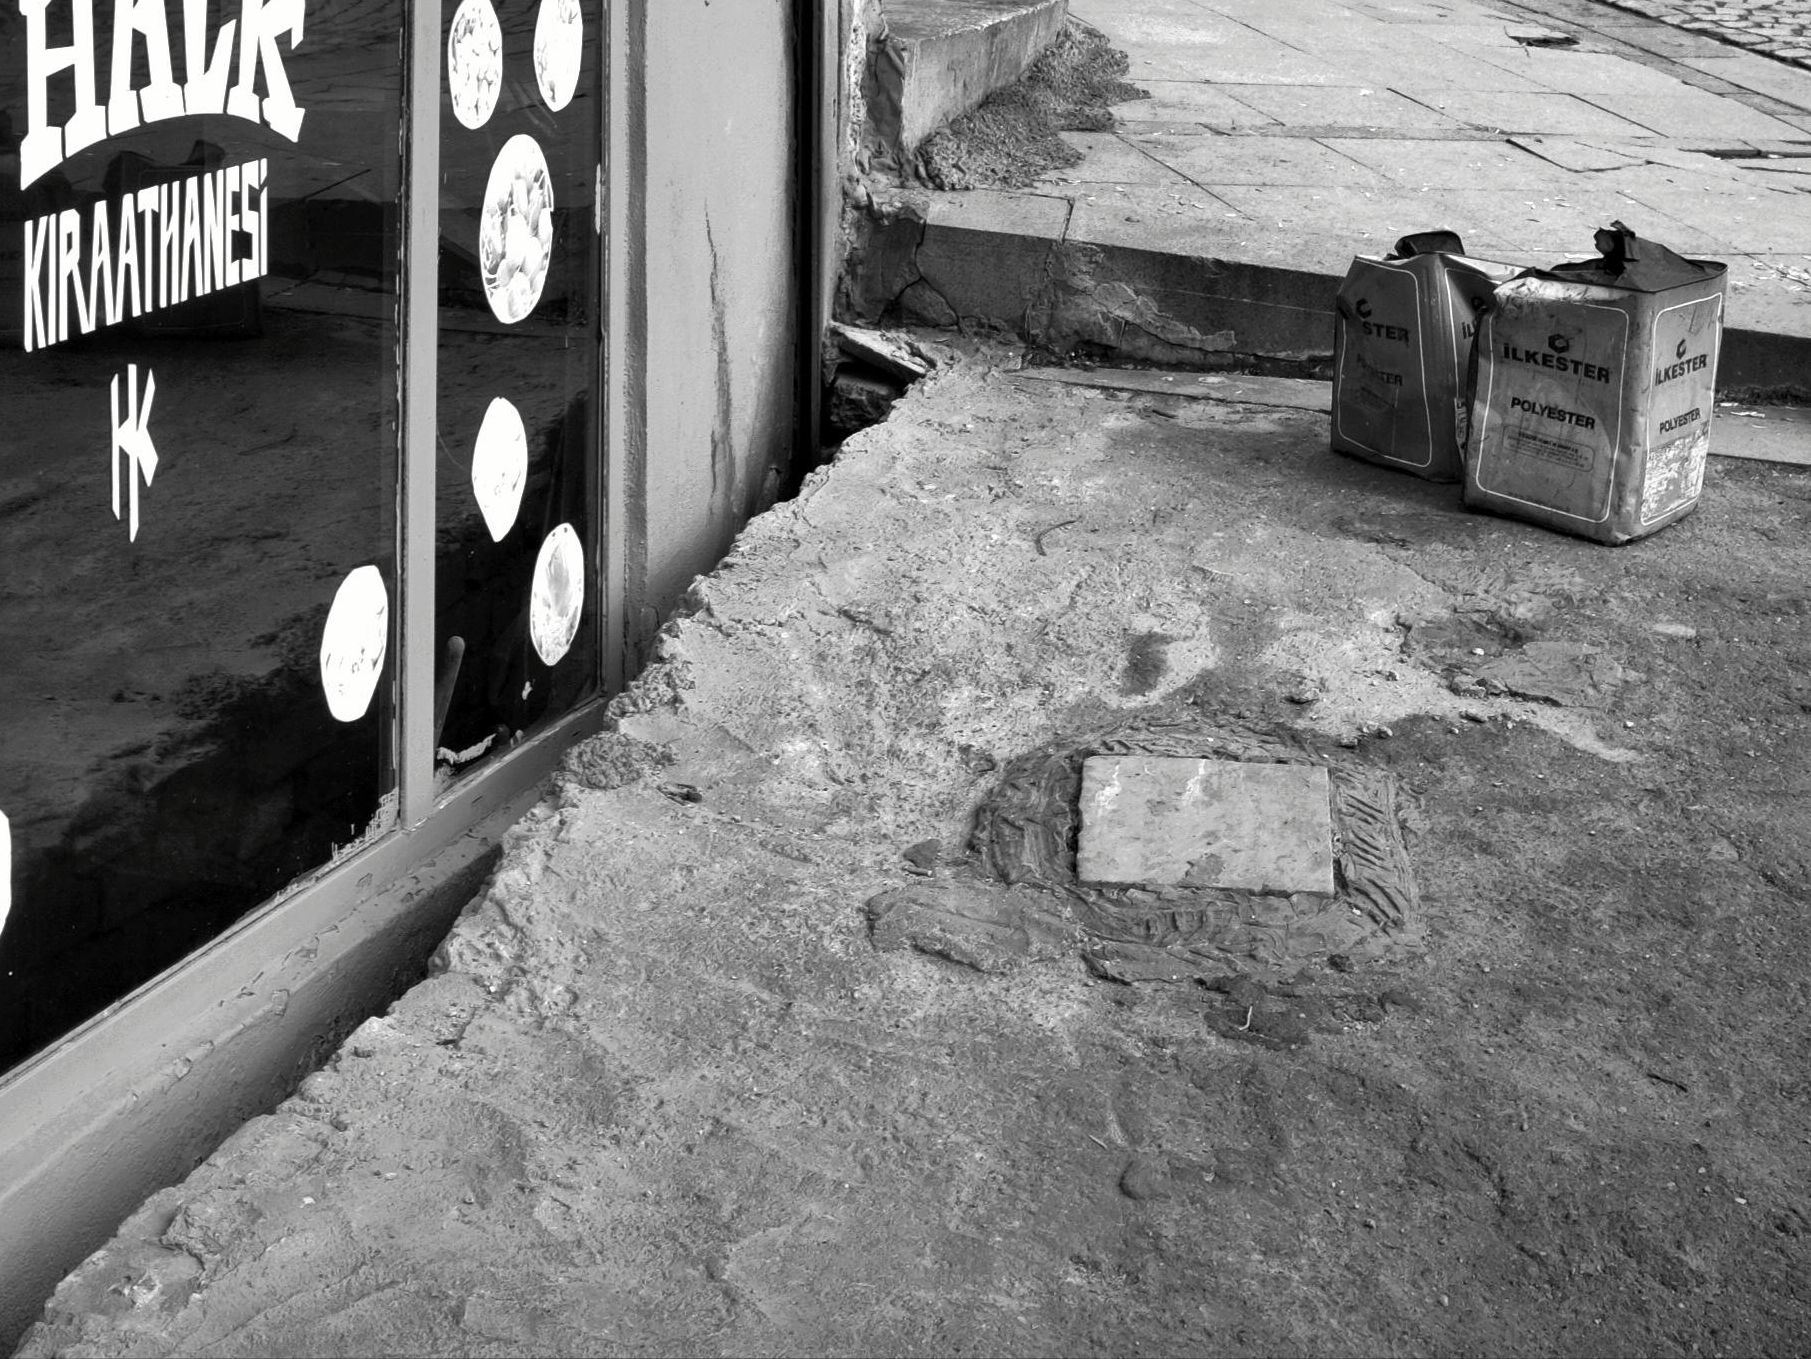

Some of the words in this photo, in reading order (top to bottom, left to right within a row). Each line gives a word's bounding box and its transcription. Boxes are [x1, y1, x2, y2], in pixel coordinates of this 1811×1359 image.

[24, 158, 268, 352] KIRAATHANESİ
[1510, 396, 1596, 430] POLYESTER
[1659, 407, 1701, 434] POLYESTER
